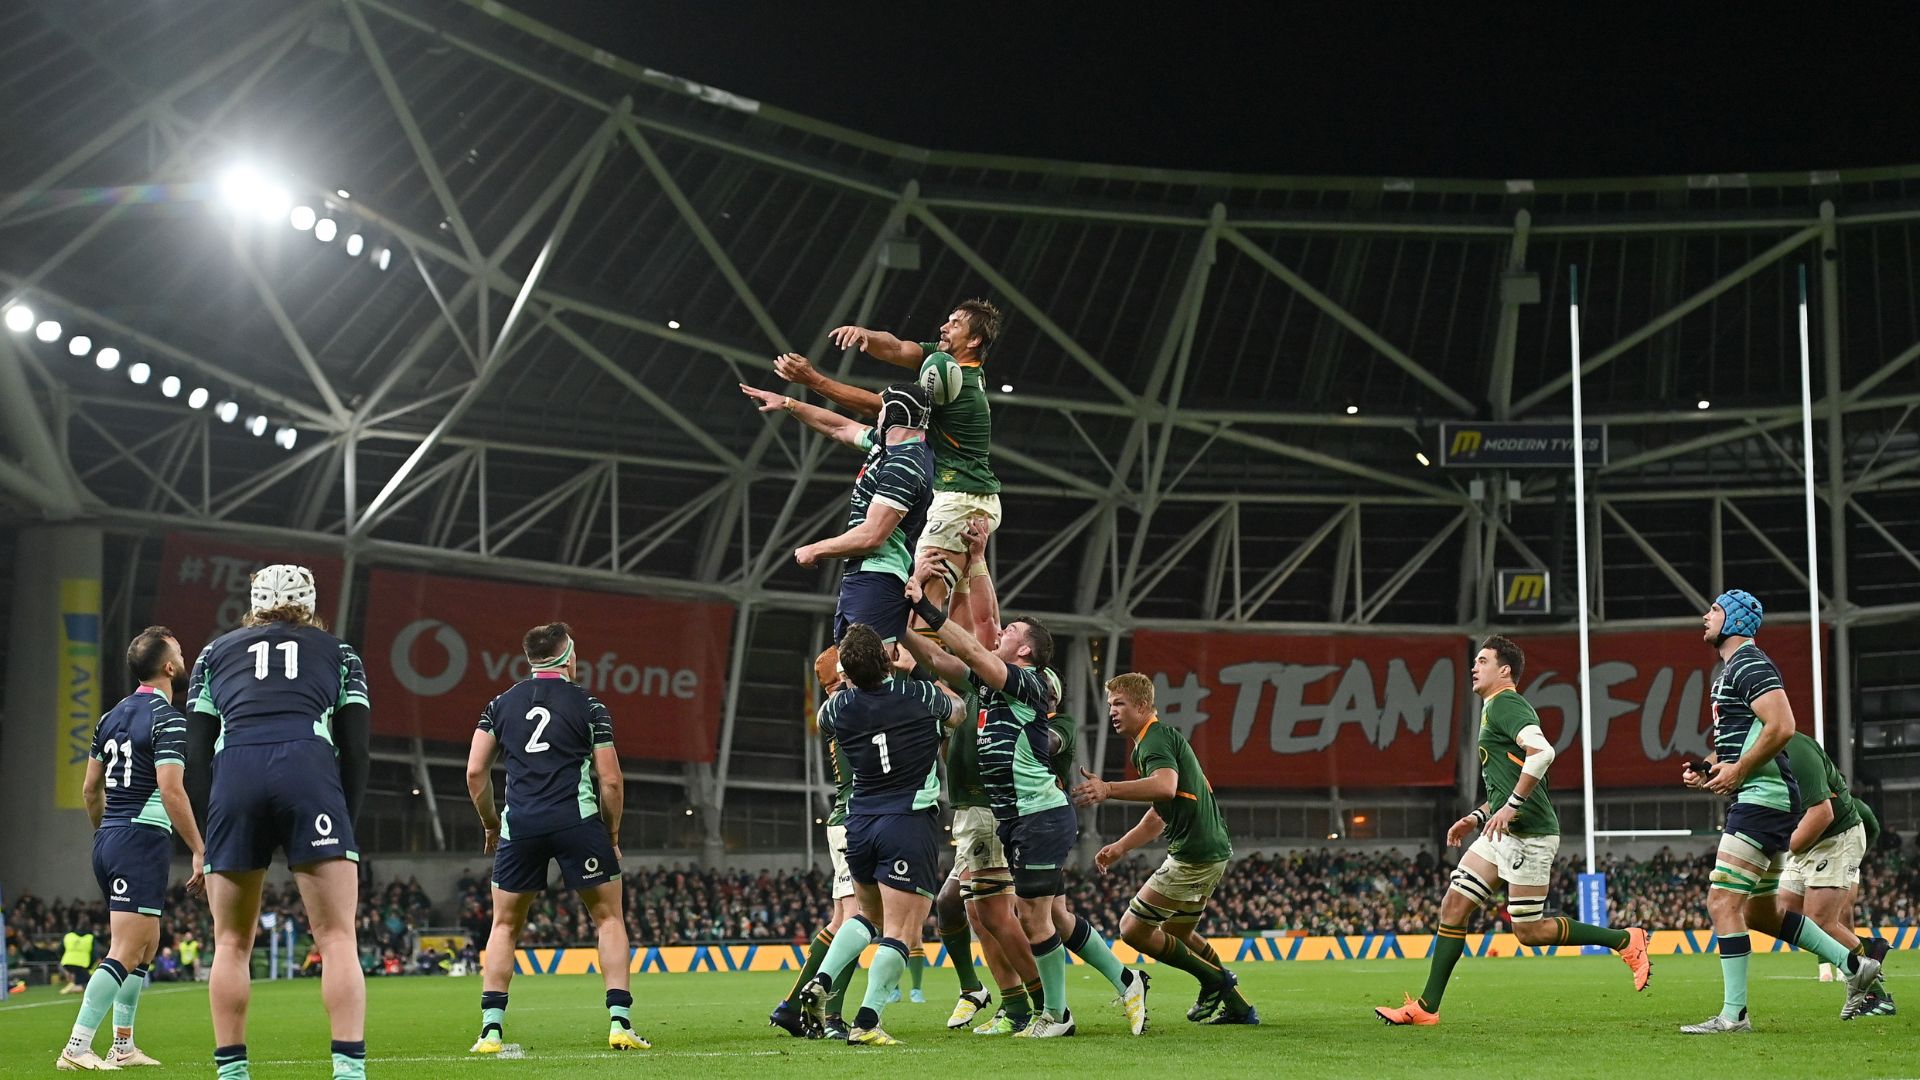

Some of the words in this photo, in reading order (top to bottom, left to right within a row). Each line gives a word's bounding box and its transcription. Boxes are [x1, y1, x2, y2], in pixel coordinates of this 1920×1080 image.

[1484, 438, 1548, 451] MODERN
[179, 556, 260, 593] #TE
[247, 640, 299, 681] 11
[481, 651, 698, 699] voafone
[69, 664, 91, 766] AVIVA
[525, 706, 551, 753] 2
[1152, 658, 1455, 763] #TEAM
[103, 739, 133, 788] 21
[871, 732, 891, 774] 1
